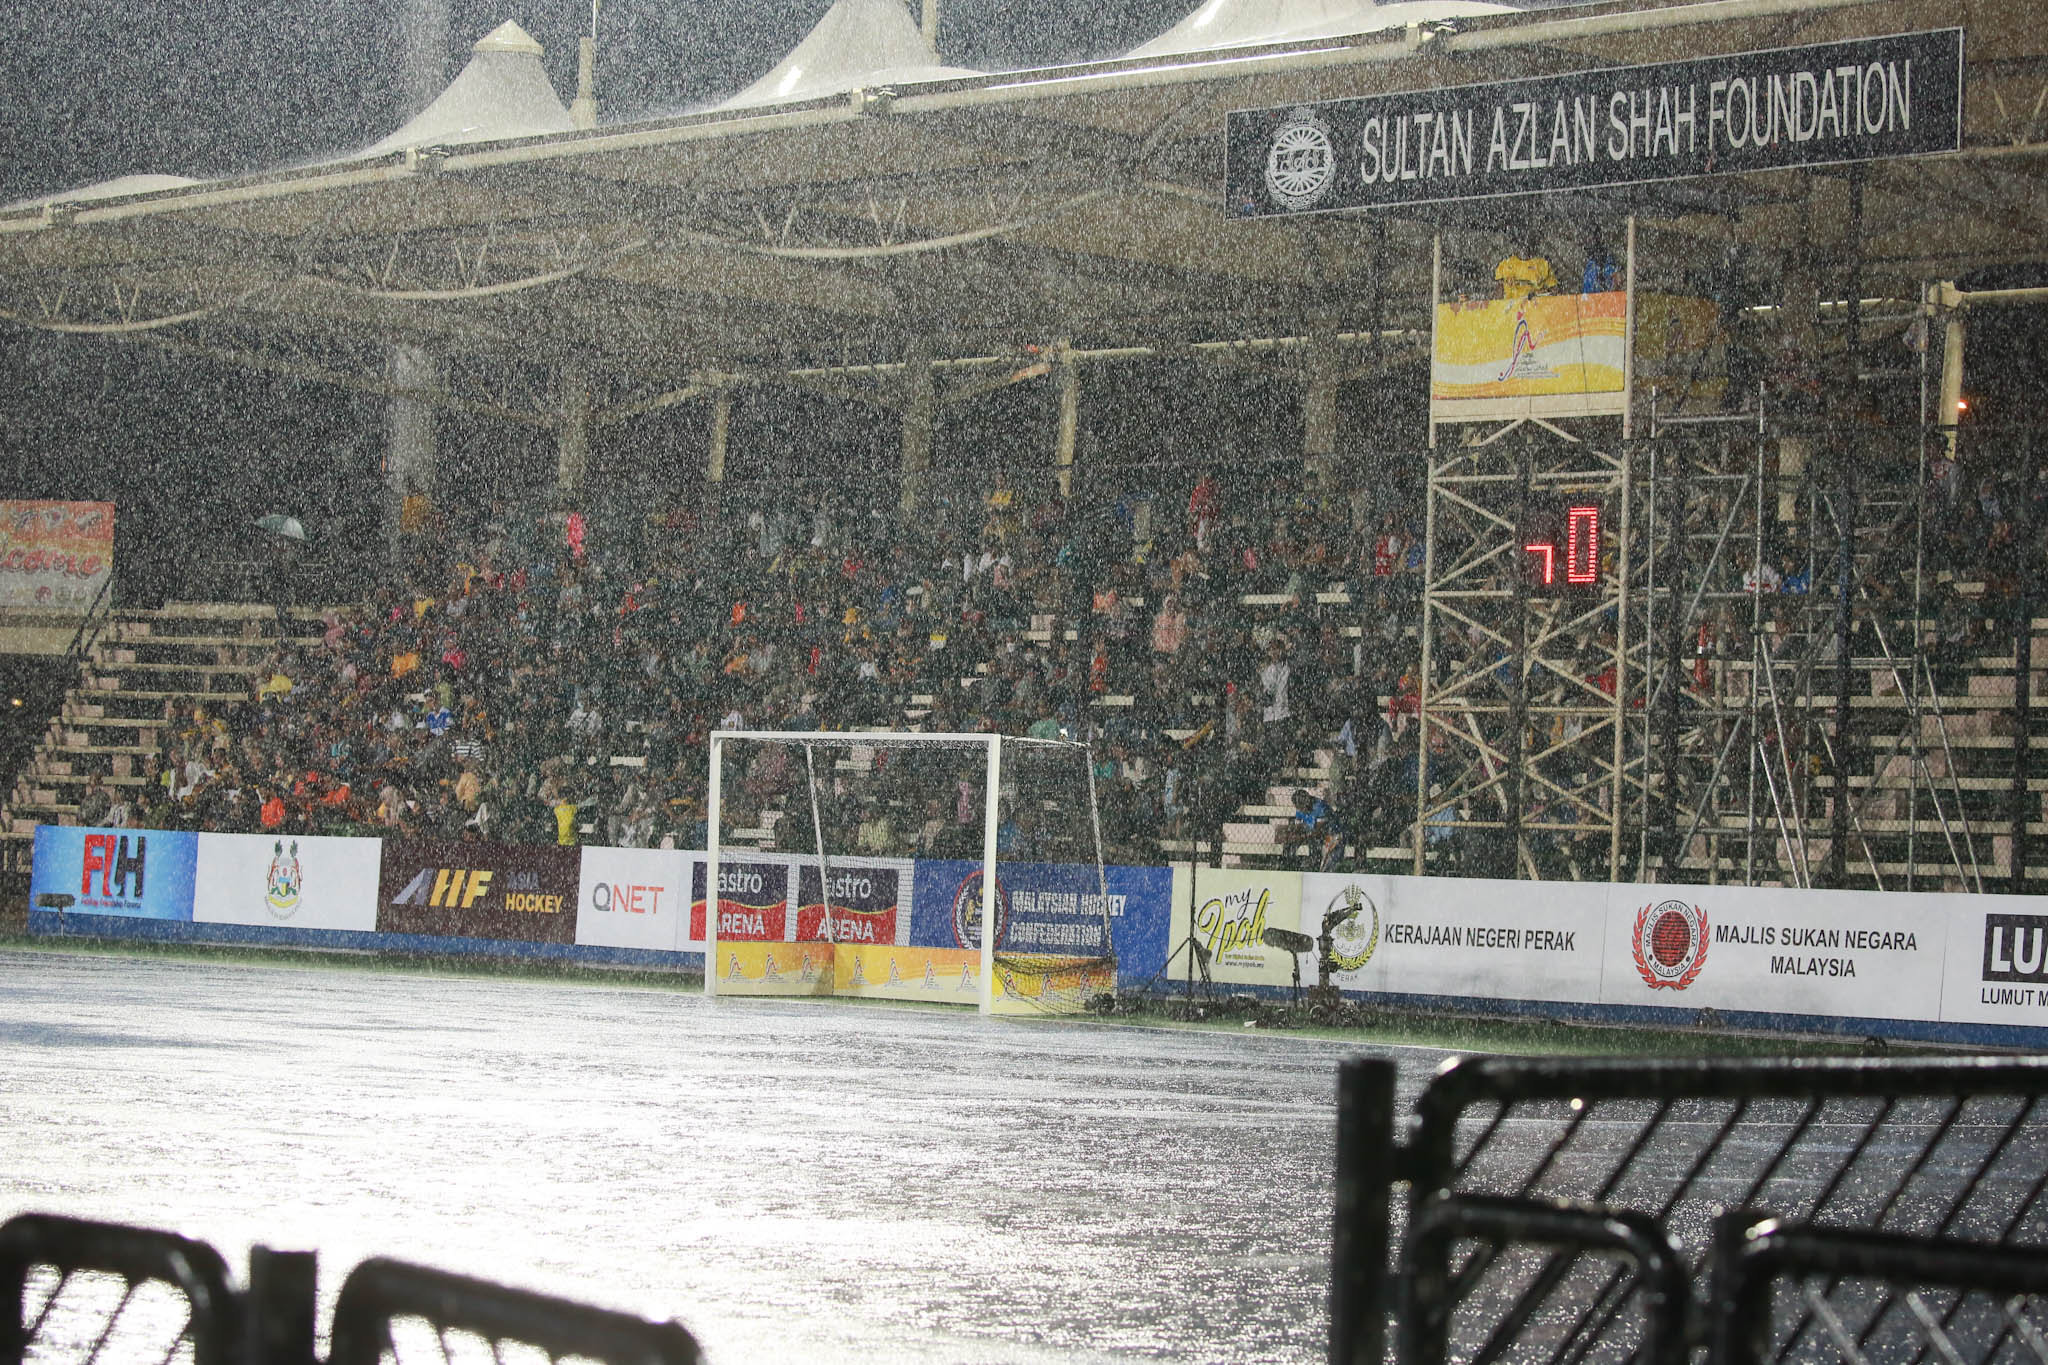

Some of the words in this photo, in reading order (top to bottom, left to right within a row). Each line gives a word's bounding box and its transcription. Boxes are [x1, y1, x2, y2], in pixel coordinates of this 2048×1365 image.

[1361, 109, 1473, 185] SULTAN
[1486, 95, 1596, 171] AZLAN
[1608, 84, 1696, 161] SHAH
[1709, 59, 1911, 149] FOUNDATION
[81, 834, 146, 898] FIH
[718, 869, 763, 893] astro
[392, 868, 493, 908] AHF
[505, 893, 563, 913] HOCKEY
[593, 882, 664, 914] QNET
[1224, 888, 1262, 919] my
[1197, 888, 1270, 964] Ipoh
[1385, 924, 1462, 947] KERAJAAN
[1466, 928, 1520, 949] NEGERI
[1525, 930, 1576, 951] PERAK
[1645, 913, 1659, 947] MAJLIS
[1658, 903, 1683, 914] SUKAN
[1684, 909, 1697, 947] NEGARA
[1715, 925, 1776, 945] MAJLIS
[1780, 927, 1840, 948] SUKAN
[1845, 930, 1918, 951] NEGARA
[1770, 955, 1856, 977] MALAYSIA
[1991, 926, 2048, 975] LU
[1653, 961, 1686, 976] MALAYSIA
[1981, 987, 2035, 1006] LUMUT
